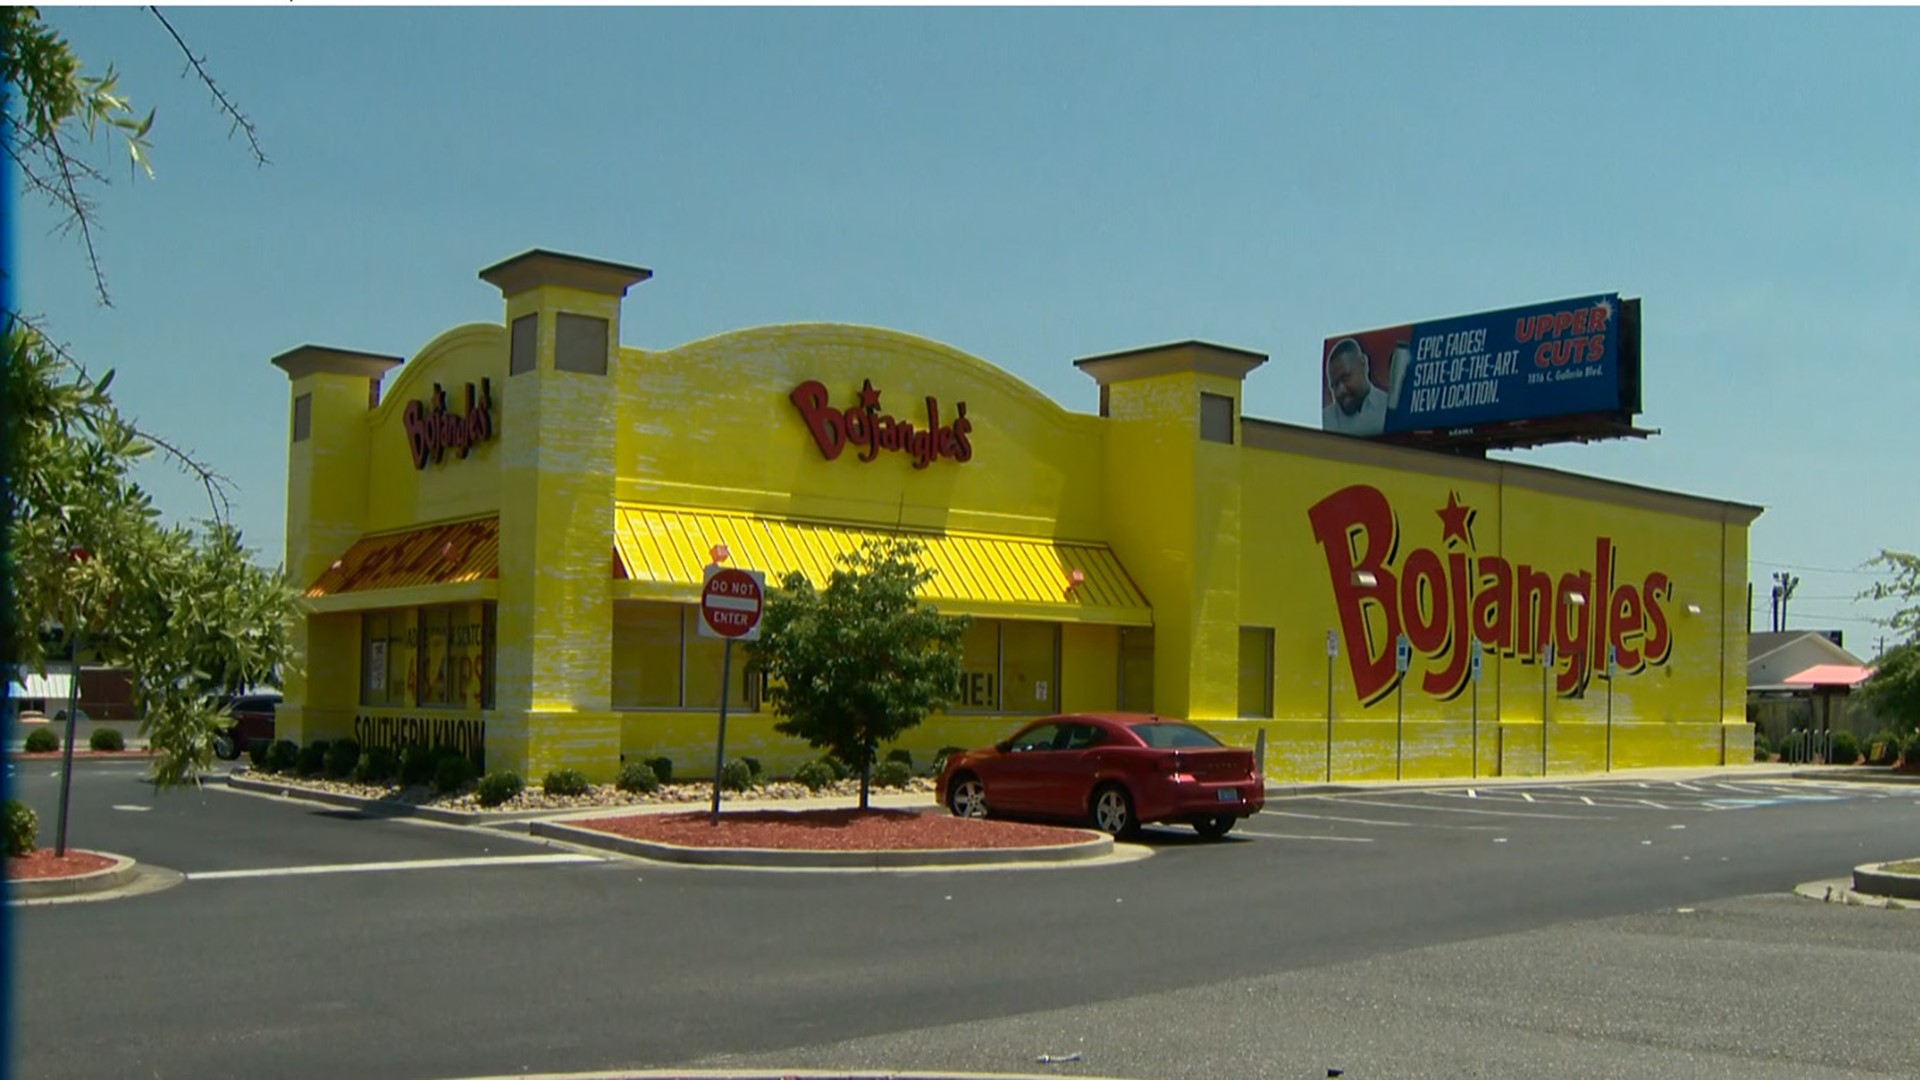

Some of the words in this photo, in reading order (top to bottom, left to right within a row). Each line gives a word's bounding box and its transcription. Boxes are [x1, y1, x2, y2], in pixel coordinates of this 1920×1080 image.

[1515, 306, 1608, 344] UPPER
[1416, 335, 1444, 361] EPIC
[1445, 328, 1487, 357] FADES!
[1535, 334, 1605, 368] CUTS
[1413, 350, 1520, 387] STATE-OF-THE-ART.
[1410, 387, 1440, 413] NEW
[1441, 379, 1500, 410] LOCATION.
[711, 579, 729, 593] DO
[732, 582, 754, 595] NOT
[713, 611, 748, 625] ENTER
[354, 715, 430, 752] SOUTHERN
